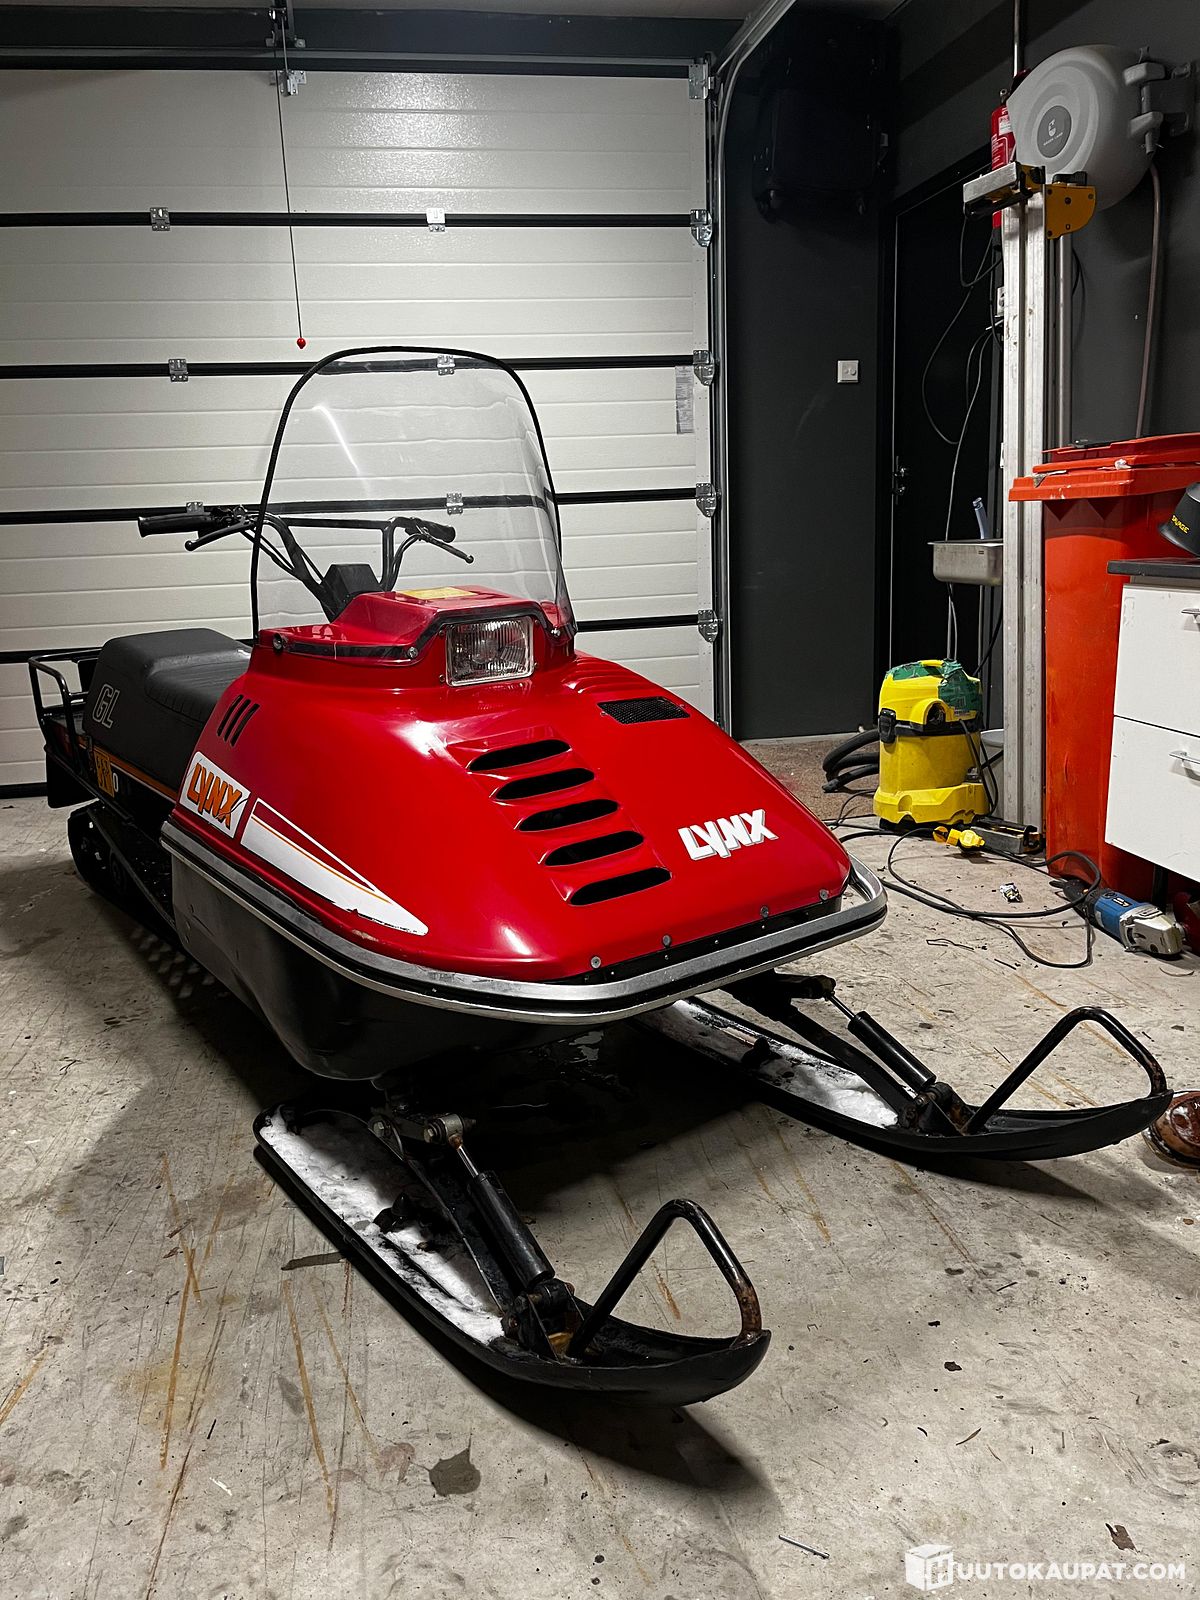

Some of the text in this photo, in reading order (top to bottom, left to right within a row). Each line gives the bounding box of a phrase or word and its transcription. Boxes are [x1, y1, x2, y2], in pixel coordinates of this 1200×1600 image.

[93, 684, 120, 728] GL
[187, 763, 242, 830] LYNX
[678, 809, 779, 860] LYNX
